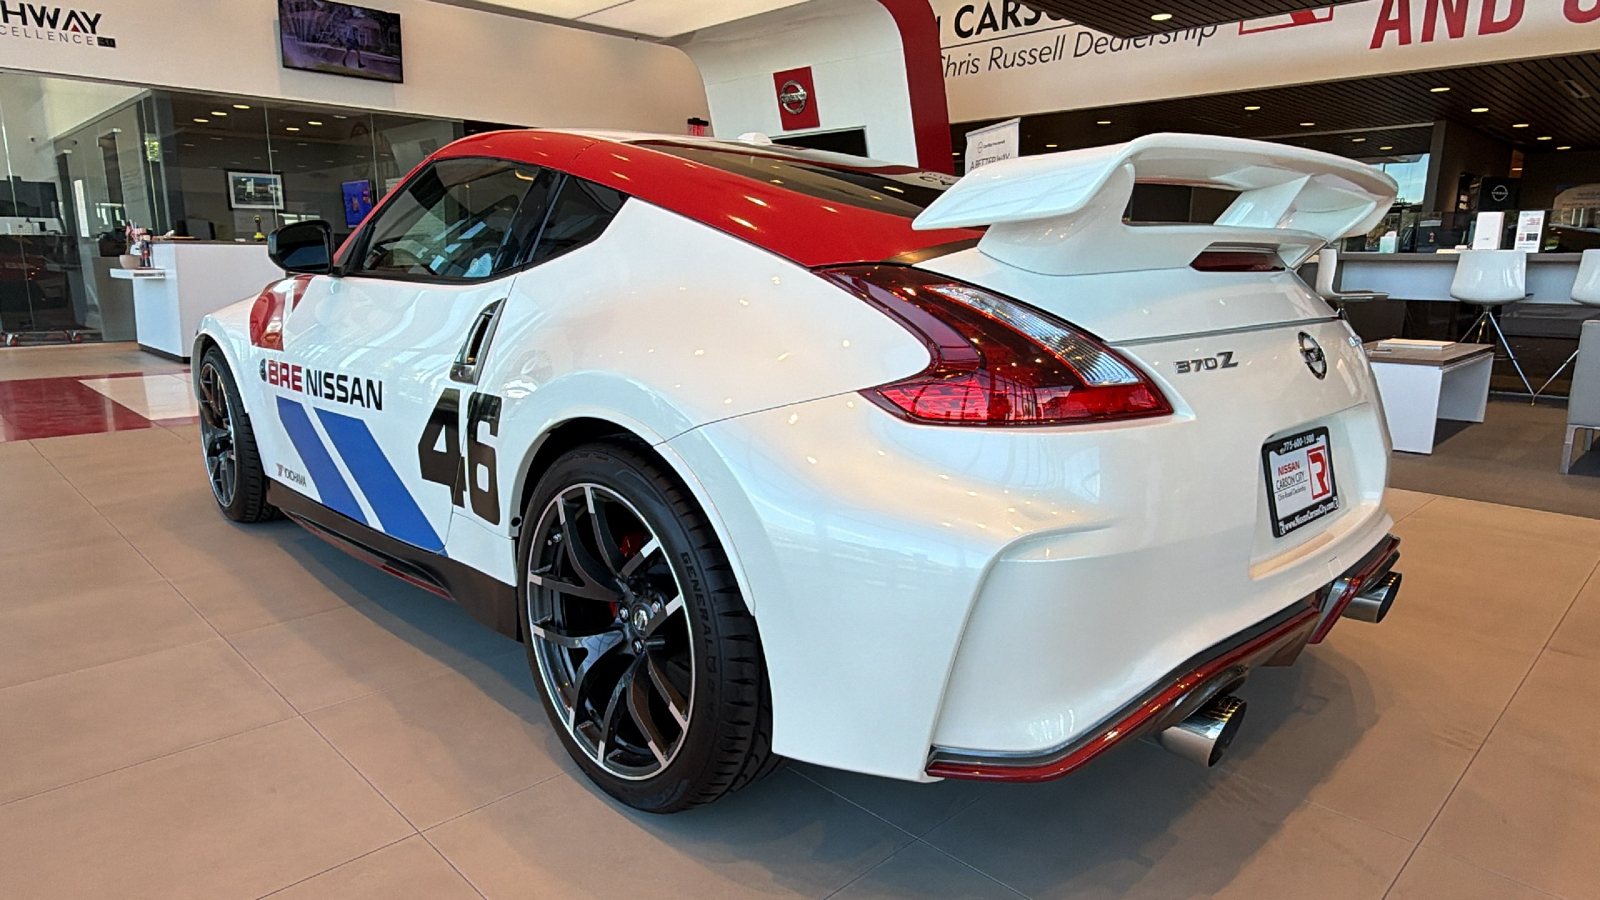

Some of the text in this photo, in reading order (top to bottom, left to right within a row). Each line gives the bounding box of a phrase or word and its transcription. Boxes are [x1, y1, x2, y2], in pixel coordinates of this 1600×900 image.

[0, 1, 102, 34] HWAY
[954, 0, 1069, 39] CARS
[1369, 0, 1526, 50] AND
[940, 53, 981, 78] hris
[988, 35, 1066, 71] Russell
[1174, 351, 1239, 374] 370Z
[267, 359, 383, 411] BRE NISSAN
[418, 387, 502, 526] 46
[1278, 460, 1301, 477] NISSAN
